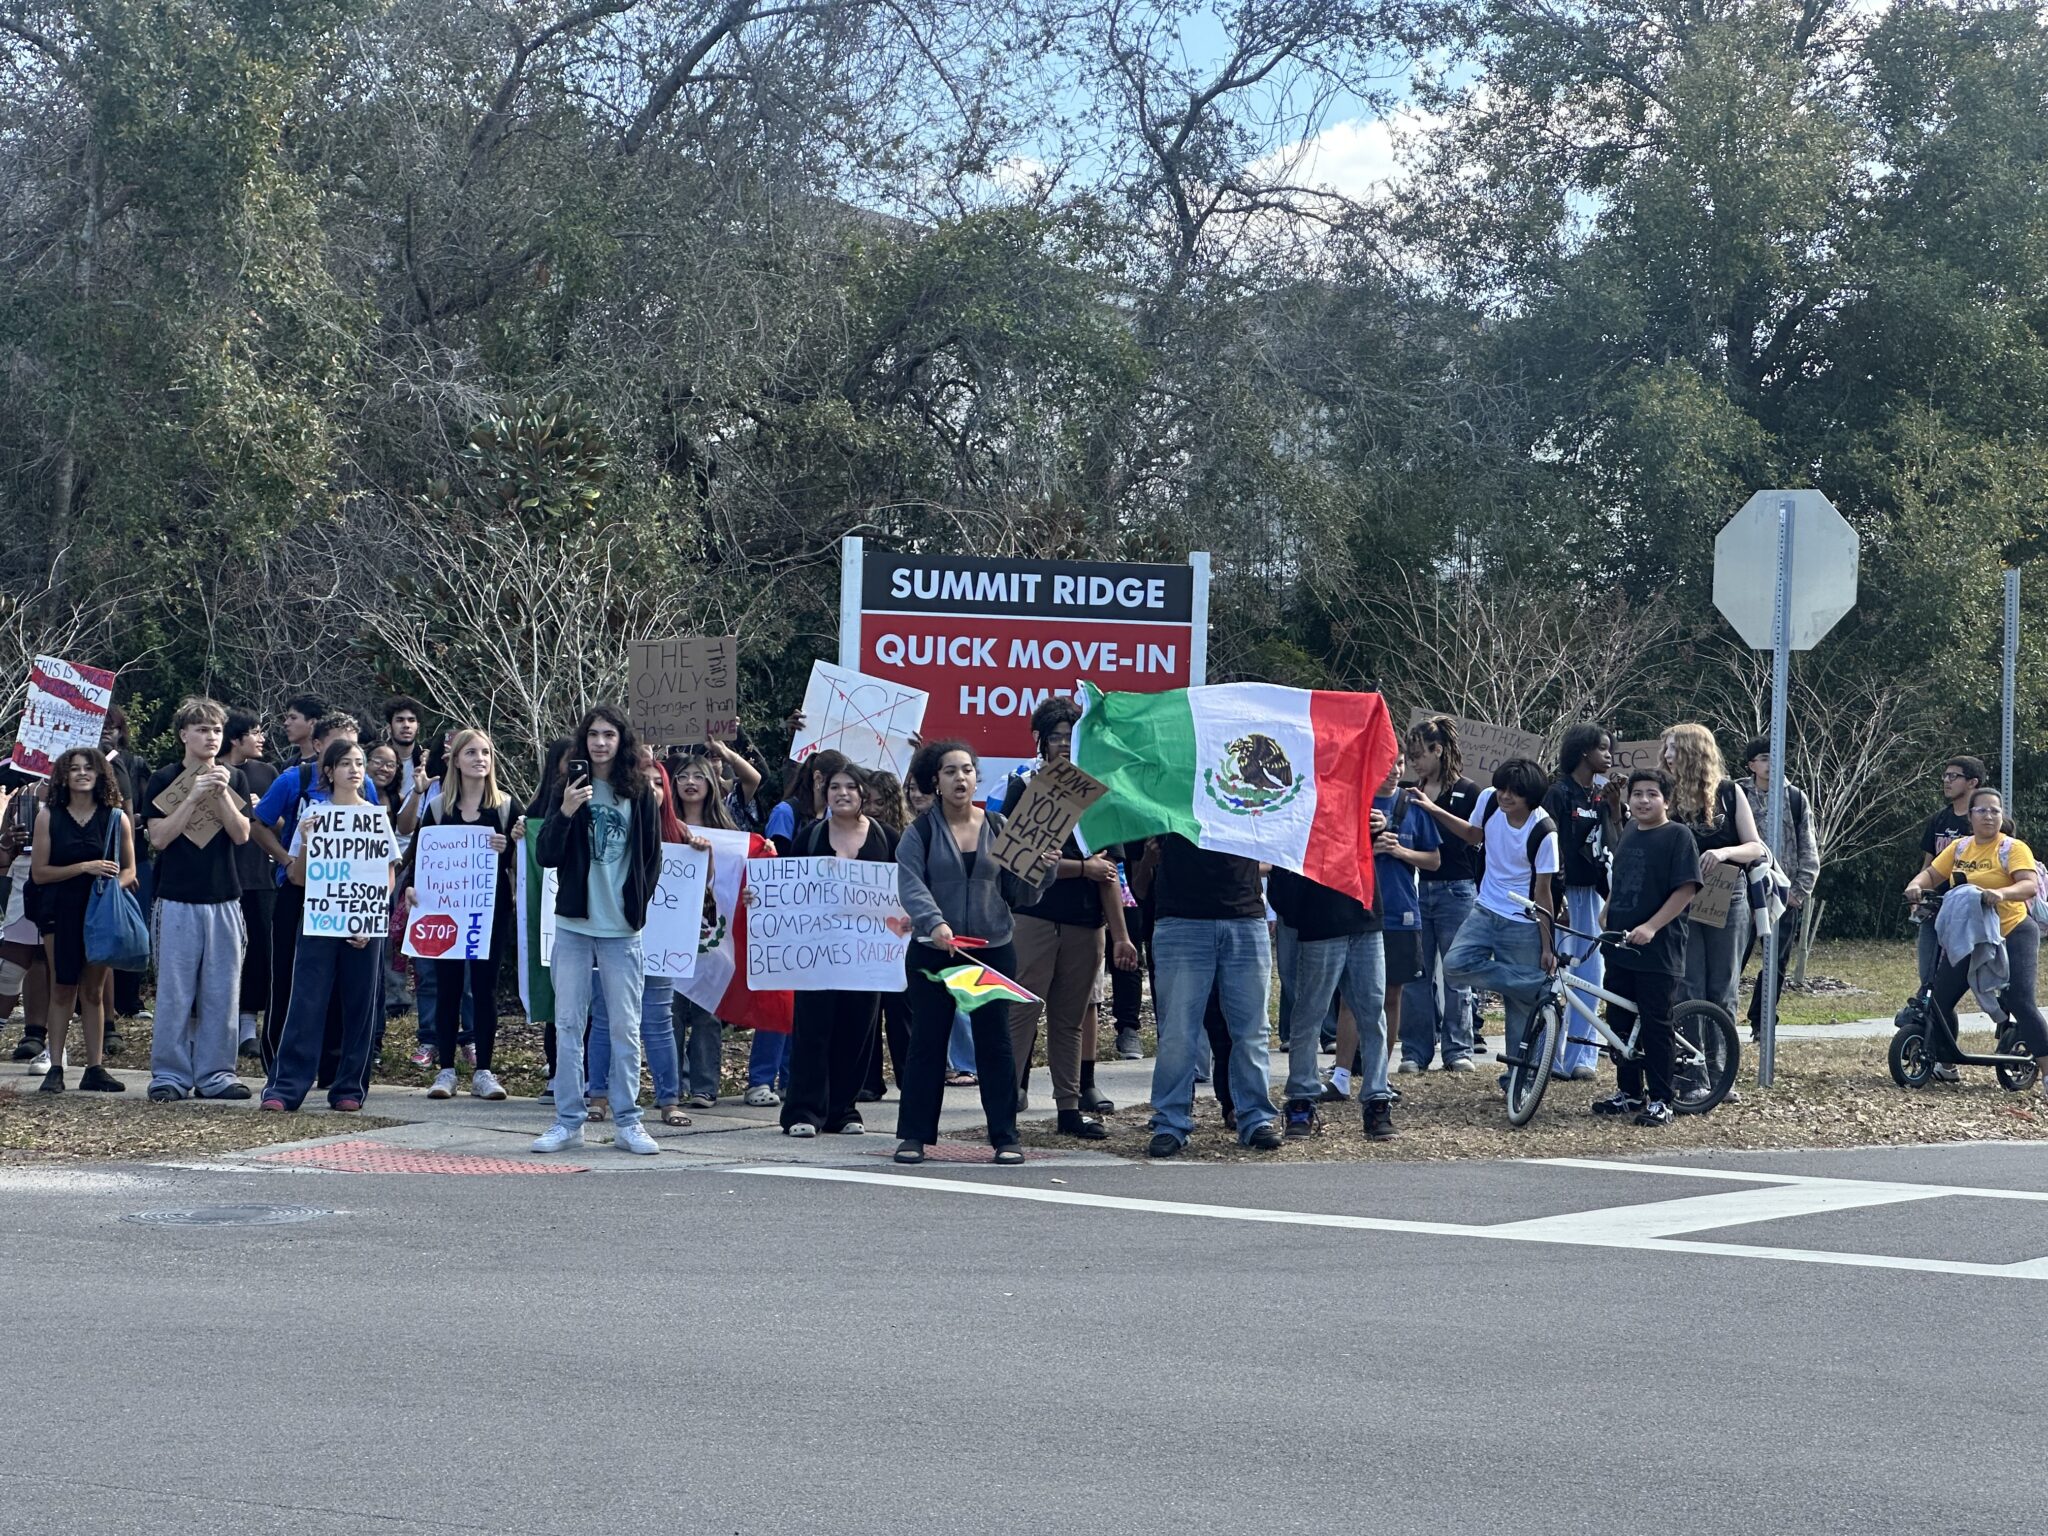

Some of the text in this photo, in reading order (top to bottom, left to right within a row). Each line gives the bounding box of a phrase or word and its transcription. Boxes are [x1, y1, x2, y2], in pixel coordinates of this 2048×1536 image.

[891, 568, 1165, 608] SUMMIT RIDGE
[636, 642, 694, 670] THE
[705, 642, 728, 689] Thing
[875, 633, 1176, 674] QUICK MOVE-IN
[36, 660, 61, 680] THIS
[64, 666, 74, 680] IS
[637, 672, 704, 698] ONLY
[636, 697, 735, 718] Stronger than
[959, 685, 1082, 717] HOM
[632, 719, 675, 739] Hate
[706, 719, 737, 736] LOVE
[1457, 722, 1532, 750] NLY THING
[1046, 762, 1097, 798] HONK
[1047, 784, 1072, 800] IF
[313, 812, 384, 834] WE ARE
[1027, 792, 1071, 837] YOU
[1010, 813, 1062, 853] HATE
[309, 836, 389, 861] SKIPPING
[992, 833, 1045, 885] ICE
[308, 861, 351, 881] OUR
[748, 858, 896, 890] WHEN CRUELTY
[326, 882, 388, 900] LESSON
[652, 884, 679, 910] De
[747, 881, 840, 910] BECOMES
[307, 898, 389, 914] TO TEACH
[309, 913, 389, 934] YOU ONE!
[415, 923, 457, 940] STOP
[465, 912, 483, 960] ICE
[749, 913, 886, 939] COMPASSION
[749, 943, 851, 976] BECOMES
